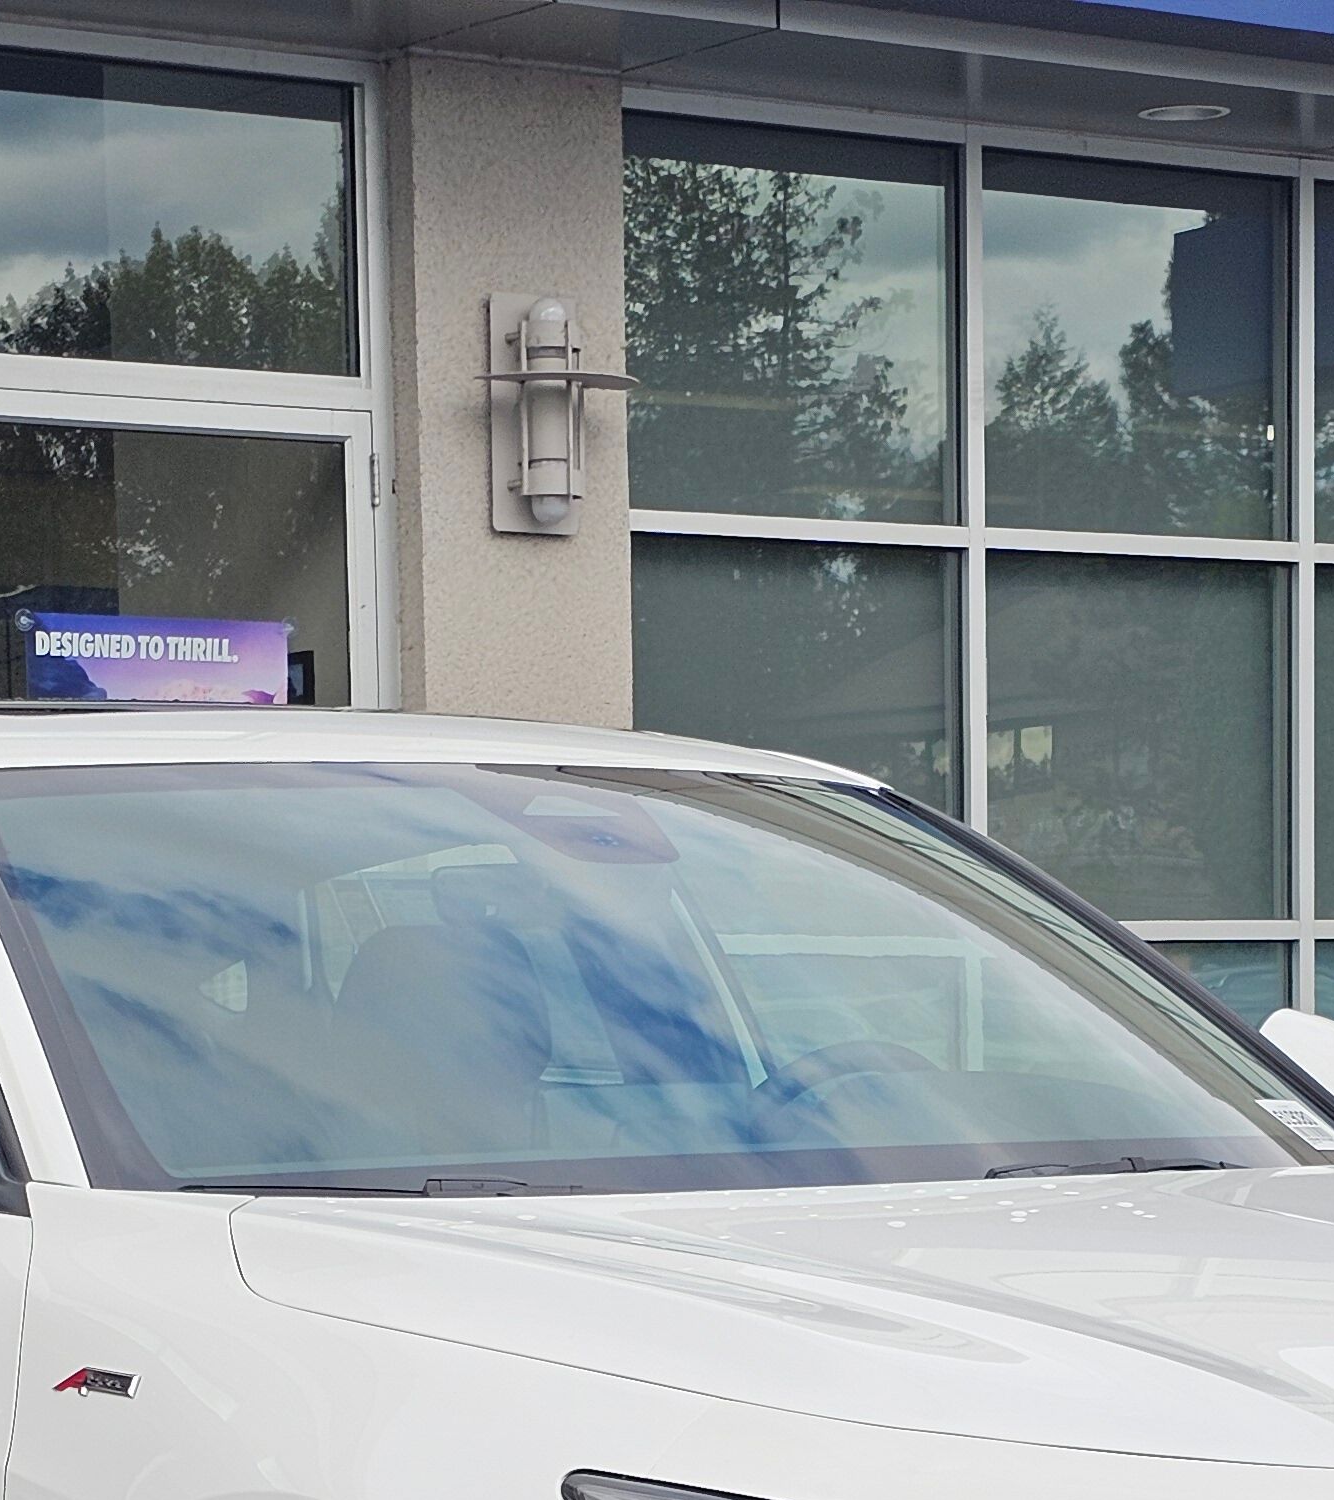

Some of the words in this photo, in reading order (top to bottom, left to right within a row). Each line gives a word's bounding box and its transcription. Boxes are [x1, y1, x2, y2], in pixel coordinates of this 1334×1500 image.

[35, 631, 136, 659] DESIGNED
[138, 636, 164, 660] TO
[166, 637, 239, 663] THRILL.
